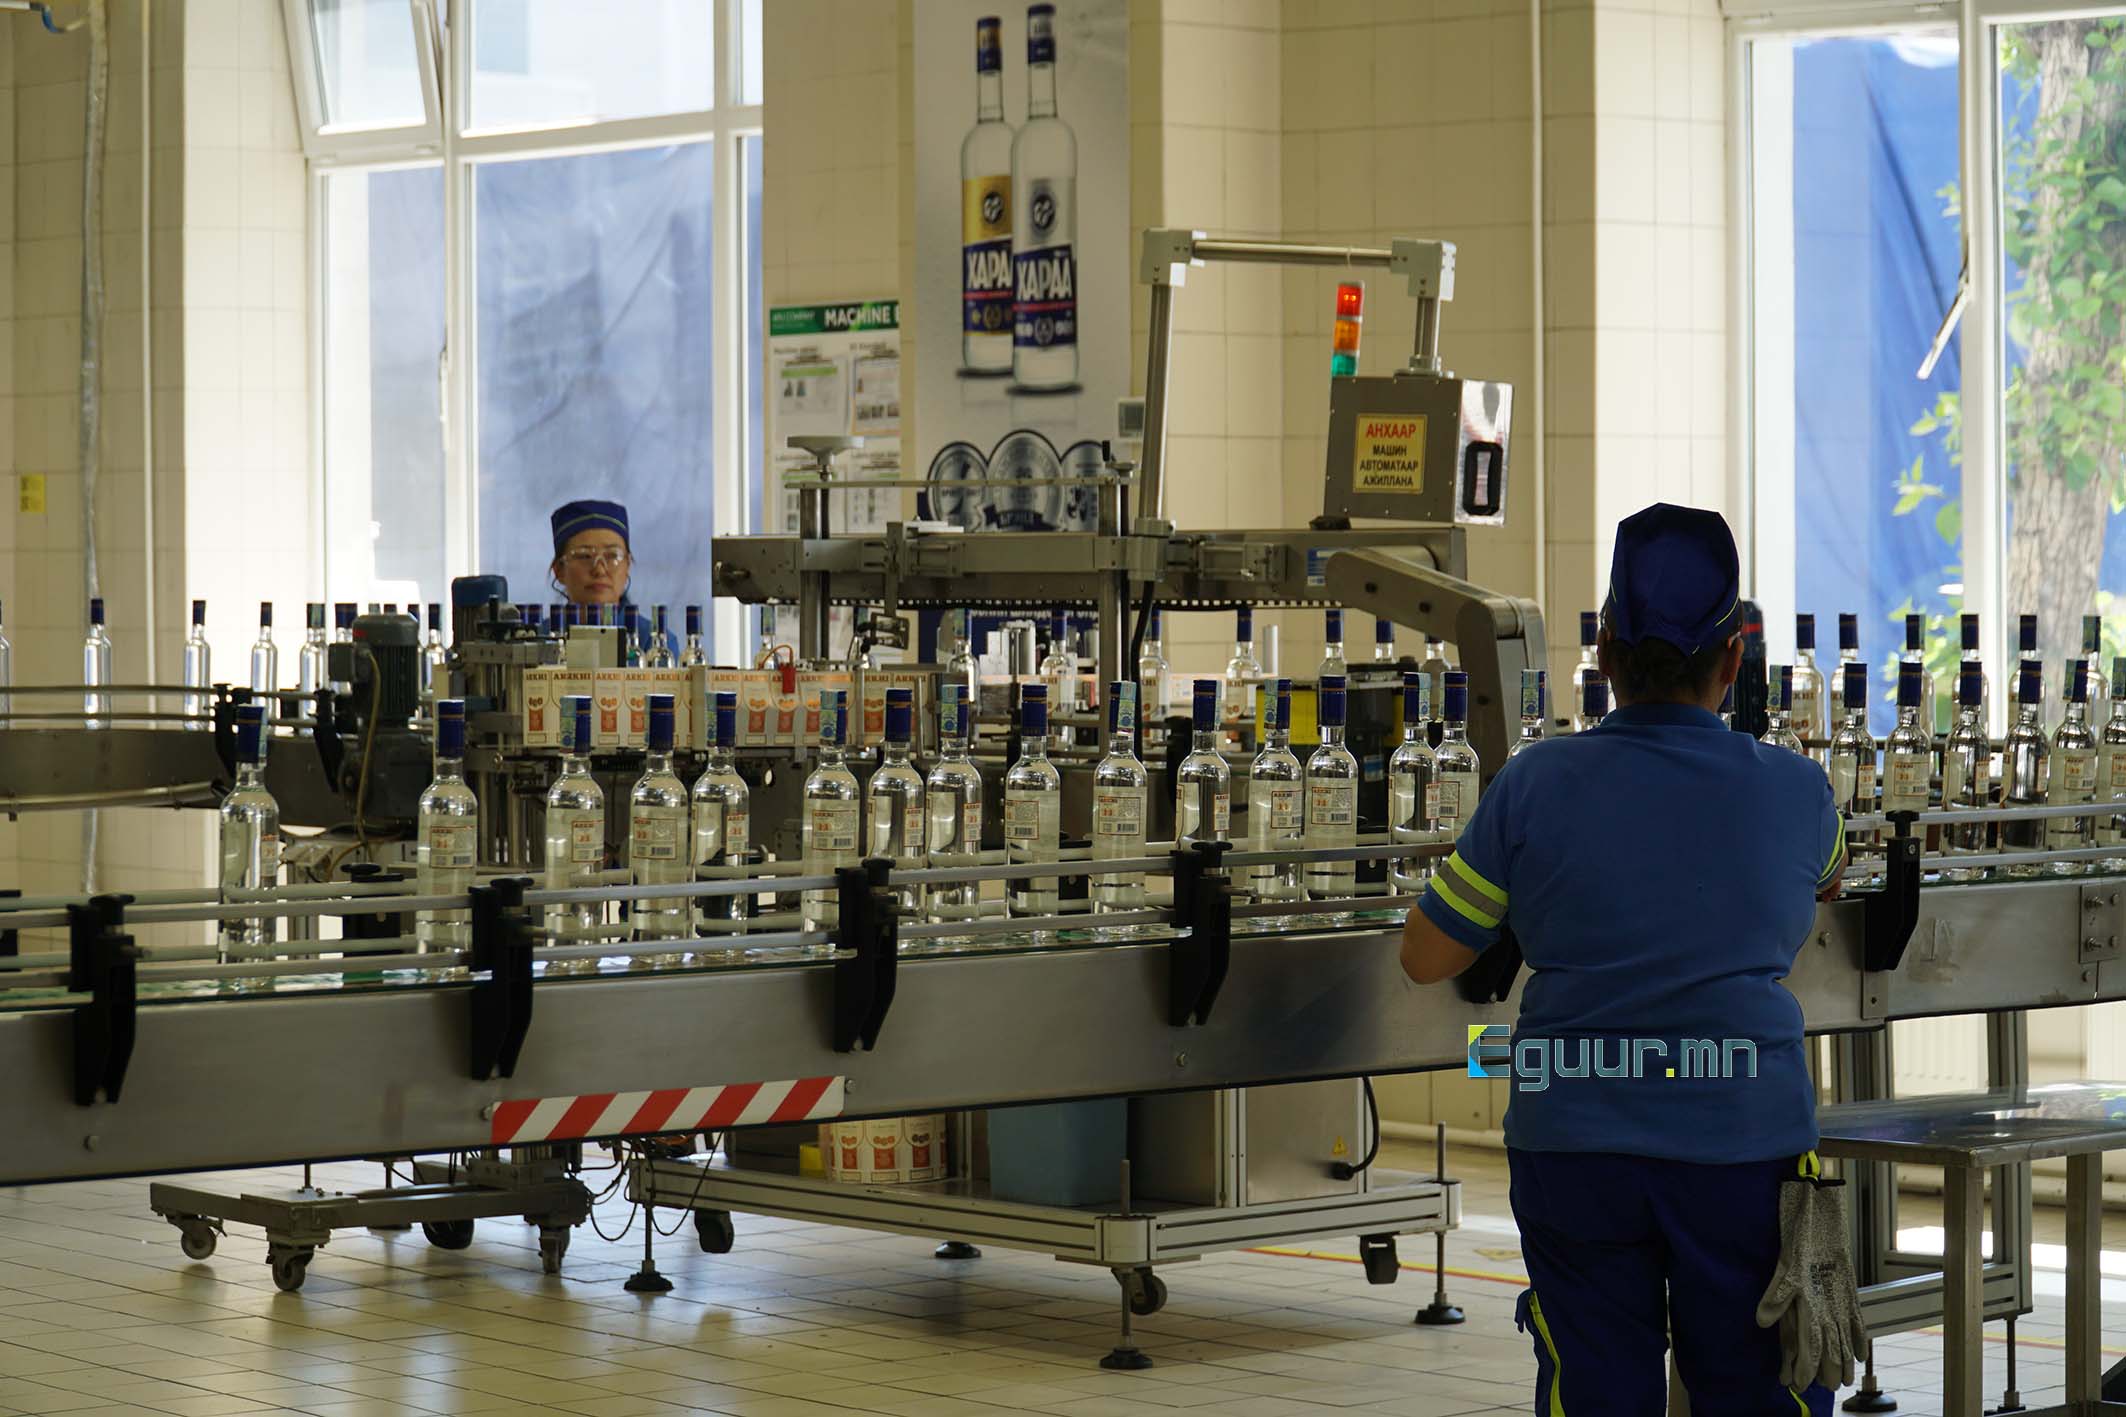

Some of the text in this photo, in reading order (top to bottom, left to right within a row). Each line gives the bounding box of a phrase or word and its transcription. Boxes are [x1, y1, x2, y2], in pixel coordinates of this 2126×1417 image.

[1015, 258, 1073, 302] ХАРАА
[824, 305, 891, 328] MACHINE
[1366, 423, 1417, 439] АНХААР
[1372, 445, 1408, 457] МАШИН
[1359, 460, 1419, 472] АВТОМАТААР
[1363, 475, 1414, 487] АЖИЛЛАНА
